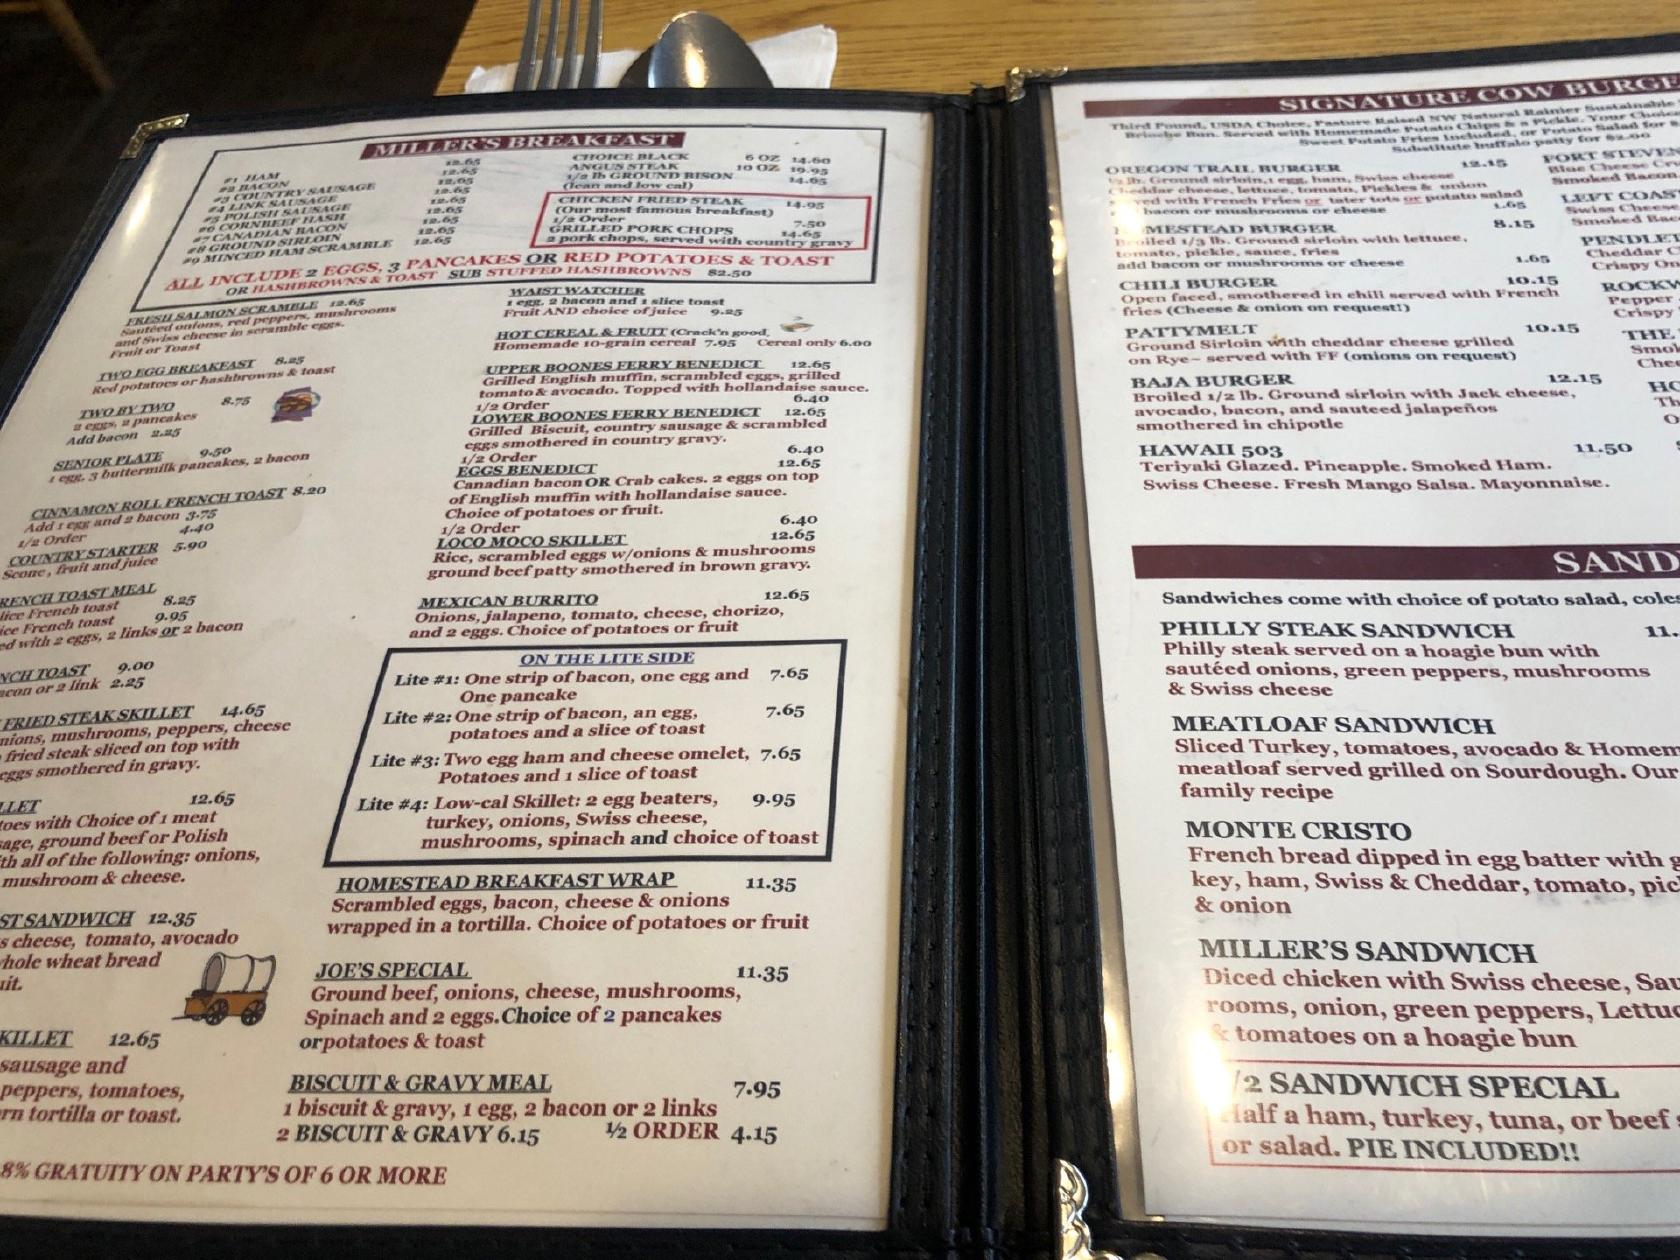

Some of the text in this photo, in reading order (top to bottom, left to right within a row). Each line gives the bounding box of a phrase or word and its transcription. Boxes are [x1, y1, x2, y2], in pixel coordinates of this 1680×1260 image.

[1279, 91, 1471, 112] SIGNATURE
[1477, 84, 1554, 101] COW
[373, 133, 675, 157] MILLER'S BREAKFAST
[1105, 159, 1508, 174] OREGON TRAIL BURGER 12.15
[164, 278, 204, 292] ALL
[209, 268, 302, 286] INCLUDE
[305, 269, 319, 277] 2
[389, 262, 401, 274] 3
[407, 253, 521, 270] PANCAKES
[524, 253, 557, 266] OR
[563, 252, 610, 264] RED
[615, 252, 733, 265] POTATOES
[739, 254, 756, 265] &
[760, 254, 835, 267] TOAST
[448, 268, 482, 279] SUB
[487, 266, 562, 277] STUFFED
[566, 265, 692, 277] HASHBROWNS
[1119, 275, 1559, 291] CHILI BURGER 10.15
[1125, 323, 1580, 339] PATTYMELT 10.15
[493, 339, 579, 351] Homemade
[584, 338, 646, 349] 10-grain
[649, 338, 696, 346] cereal
[704, 339, 736, 347] 7.95
[806, 339, 836, 347] only
[839, 339, 872, 347] 6.00
[97, 356, 305, 384] TWO EGG BREAKFAST 8.25
[485, 359, 831, 376] UPPER BOONES FERRY BENEDICT 12.65
[1130, 373, 1603, 390] BAJA BURGER 12.15
[1139, 443, 1633, 458] HAWAII 503 11.50
[52, 452, 164, 473] SENIOR PLATE
[456, 464, 598, 478] EGGS BENEDICT
[30, 486, 326, 521] CINNAMON ROLL FRENCH TOAST 8.20
[436, 529, 815, 549] LOCO MOCO SKILLET 12.65
[1552, 550, 1680, 575] SAND
[417, 589, 809, 610] MEXICAN BURRITO 12.65
[1160, 621, 1515, 639] PHILLY STEAK SANDWICH
[519, 651, 695, 667] ON THE LITE SIDE
[394, 667, 809, 687] Lite #1: One strip of bacon, one egg and 7.65
[1, 703, 266, 733] FRIED STEAK SKILLET 14.65
[1171, 716, 1496, 735] MEATLOAF SANDWICH
[356, 791, 796, 813] Lite #4: Low-cal Skillet: 2 egg beaters, 9.95
[1184, 820, 1412, 841] MONTE CRISTO
[336, 871, 797, 893] HOMESTEAD BREAKFAST WRAP 11.35
[1198, 938, 1539, 964] MILLER'S SANDWICH
[288, 1074, 781, 1099] BISCUIT & GRAVY MEAL 7.95
[1270, 1071, 1620, 1100] SANDWICH SPECIAL
[276, 1128, 289, 1143] 2
[294, 1124, 389, 1143] BISCUIT
[391, 1124, 409, 1143] &
[413, 1125, 494, 1143] GRAVY
[497, 1125, 540, 1147] 6.15
[633, 1121, 720, 1140] ORDER
[730, 1126, 778, 1145] 4.15
[1260, 1134, 1580, 1162] salad. PIE INCLUDED!!
[34, 1162, 147, 1182] GRATUITY
[149, 1164, 183, 1182] ON
[284, 1165, 317, 1184] OF
[320, 1165, 334, 1184] 6
[339, 1166, 373, 1184] OR
[376, 1166, 447, 1186] MORE
